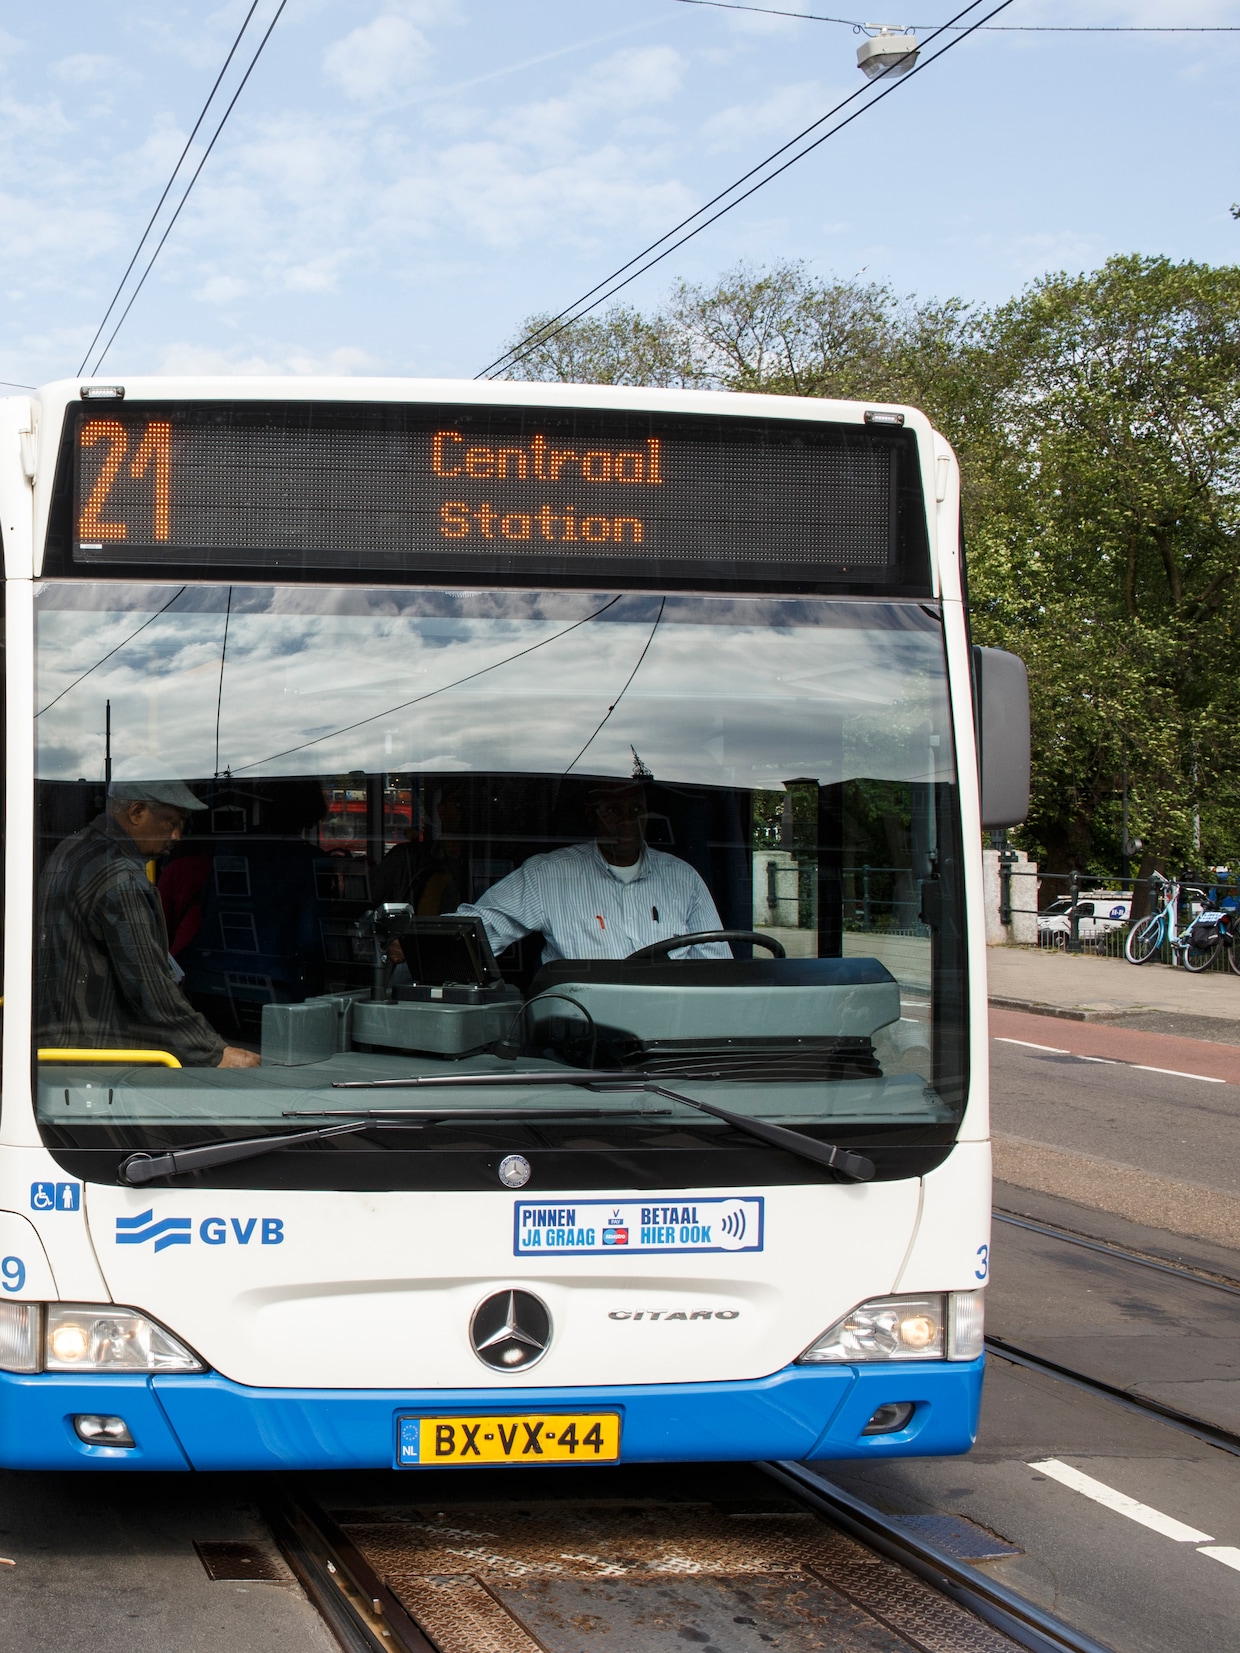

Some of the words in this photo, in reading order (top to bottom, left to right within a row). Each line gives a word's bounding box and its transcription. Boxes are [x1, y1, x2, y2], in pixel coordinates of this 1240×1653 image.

[433, 431, 662, 483] Centraal
[79, 420, 170, 539] 21
[440, 502, 642, 542] Station
[522, 1208, 576, 1227] PINNEN
[641, 1207, 699, 1225] BETAAL
[198, 1217, 285, 1245] GVB
[522, 1229, 541, 1247] JA
[546, 1228, 595, 1247] GRAAG
[605, 1232, 626, 1240] Maestro
[640, 1226, 675, 1245] HIER
[679, 1225, 711, 1244] OOK
[607, 1307, 740, 1321] CITARO
[435, 1422, 604, 1457] BX-VX-44
[402, 1446, 417, 1457] NL
